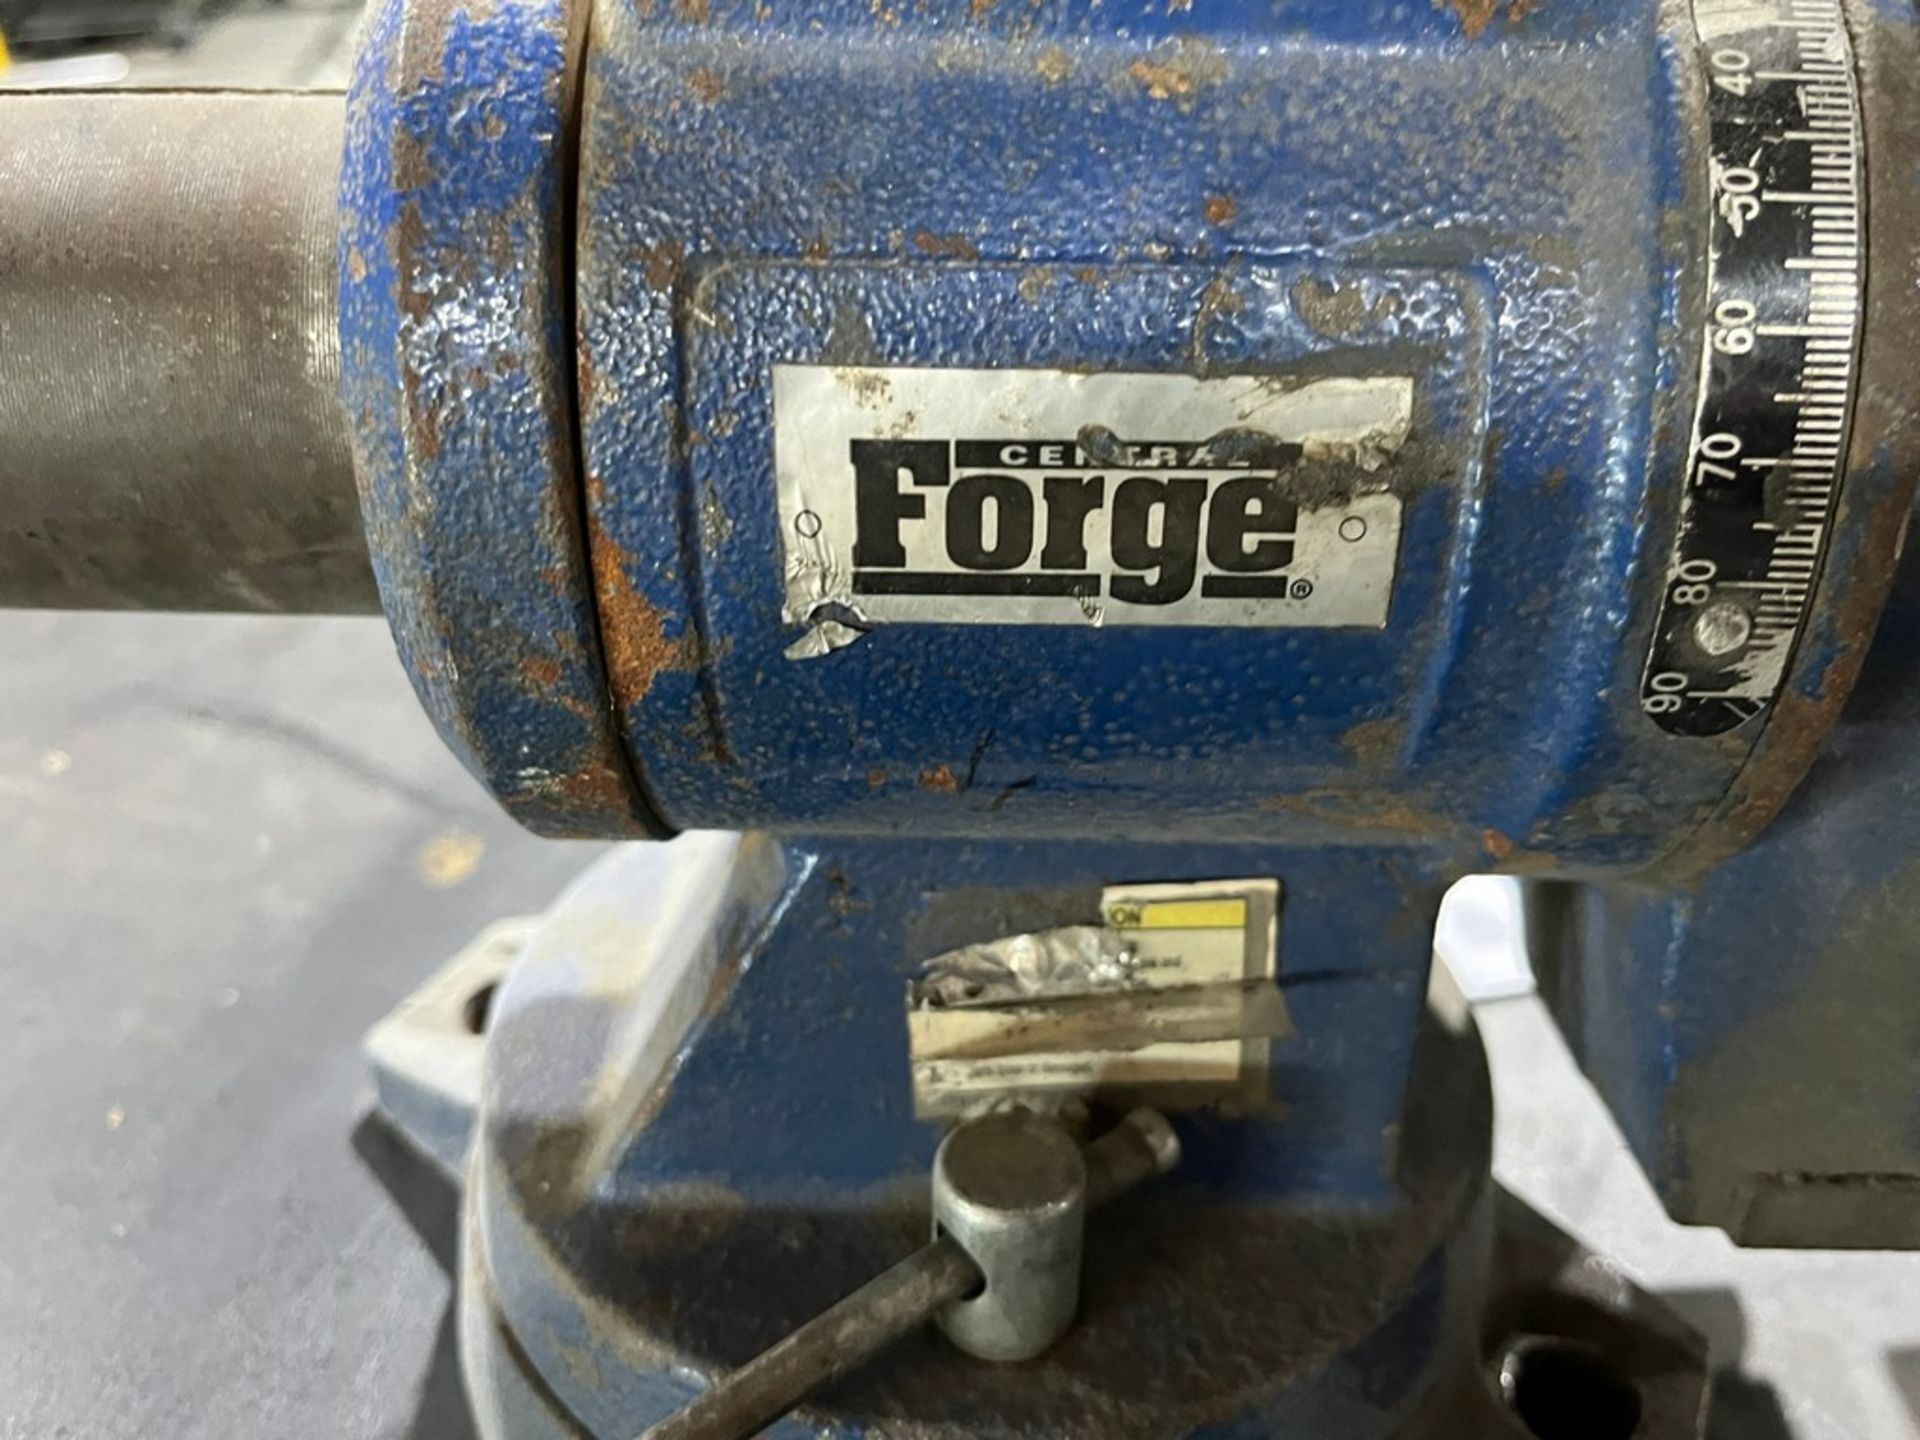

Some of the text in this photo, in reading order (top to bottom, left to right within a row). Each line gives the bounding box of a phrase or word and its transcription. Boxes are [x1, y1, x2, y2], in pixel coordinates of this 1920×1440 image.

[1711, 49, 1753, 97] 40
[1713, 299, 1756, 355] 60
[1696, 432, 1742, 487] 70
[849, 438, 1297, 605] Forge
[1673, 559, 1717, 605] 80
[1642, 671, 1688, 713] 90
